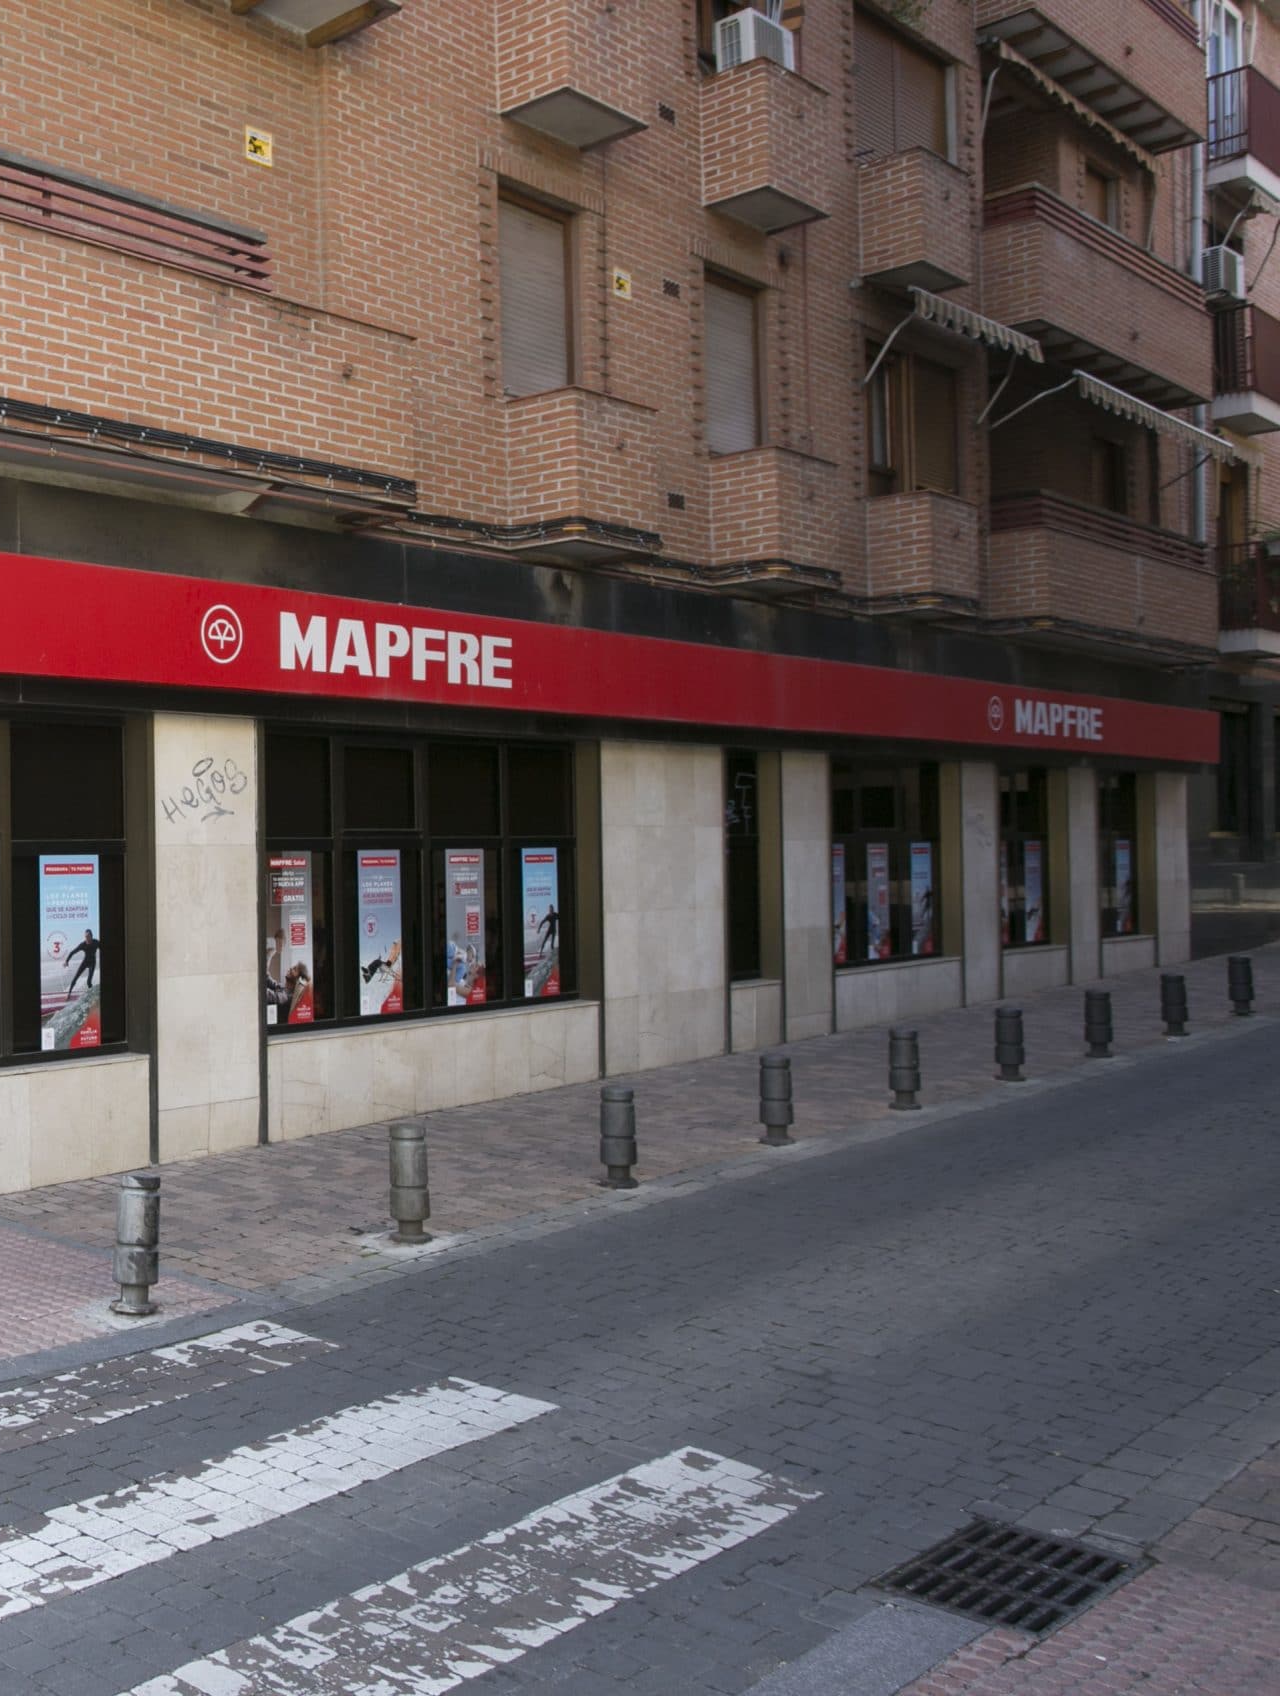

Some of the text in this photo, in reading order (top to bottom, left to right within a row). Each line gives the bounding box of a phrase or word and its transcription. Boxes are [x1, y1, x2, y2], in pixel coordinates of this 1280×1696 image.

[280, 611, 513, 689] MAPFRE
[1015, 698, 1103, 741] MAPFRE
[53, 942, 60, 953] 3
